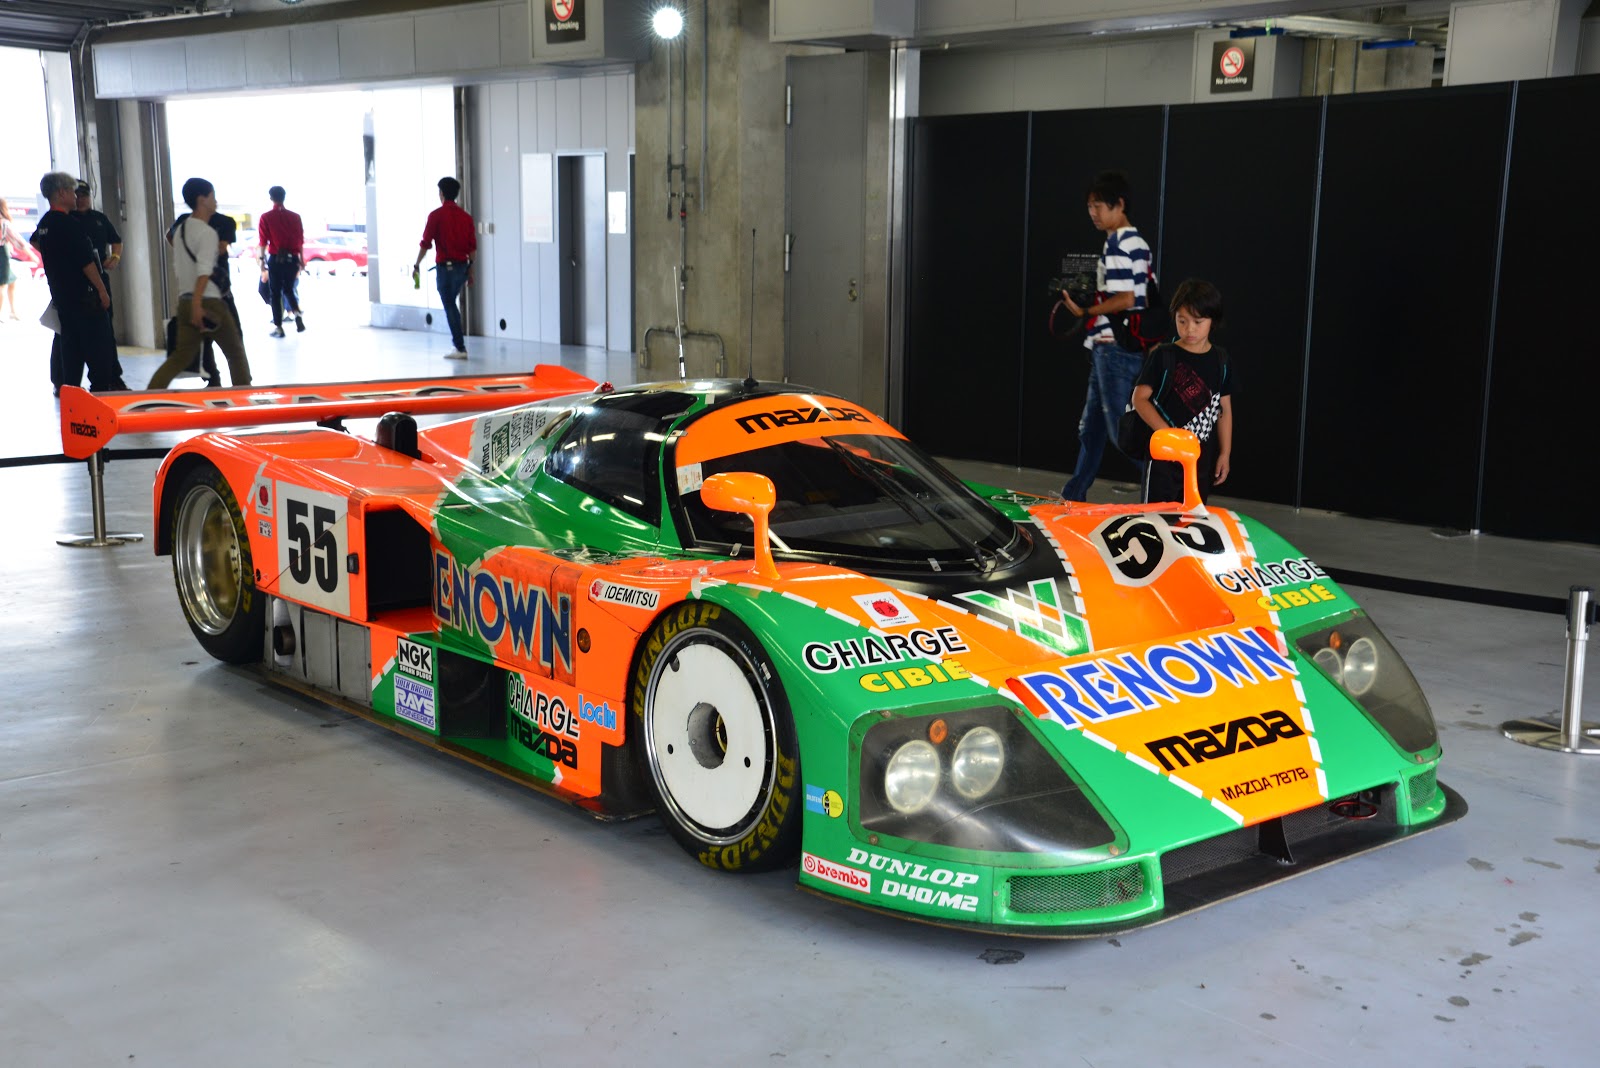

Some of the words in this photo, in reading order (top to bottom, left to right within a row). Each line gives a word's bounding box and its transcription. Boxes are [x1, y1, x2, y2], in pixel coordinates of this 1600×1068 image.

[1224, 76, 1247, 85] Smoking
[70, 420, 97, 438] mazda
[735, 407, 873, 434] mazda
[286, 498, 338, 593] 55
[1100, 513, 1226, 579] 55
[1214, 556, 1330, 595] CHARGE
[604, 585, 658, 608] IDEMITSU
[399, 642, 431, 672] NGK
[802, 625, 971, 674] CHARGE
[399, 663, 416, 676] SPARK
[416, 668, 432, 682] PLUGS
[1018, 626, 1301, 731] RENOWN
[396, 689, 434, 717] RAYS
[508, 671, 581, 741] CHARGE
[511, 710, 578, 770] mazda
[1145, 709, 1305, 772] mazda
[1221, 779, 1273, 801] MAZDA
[1270, 766, 1309, 787] 787B
[817, 860, 869, 888] brembo
[846, 847, 980, 889] DUNLOP
[881, 879, 979, 913] D40/M2
